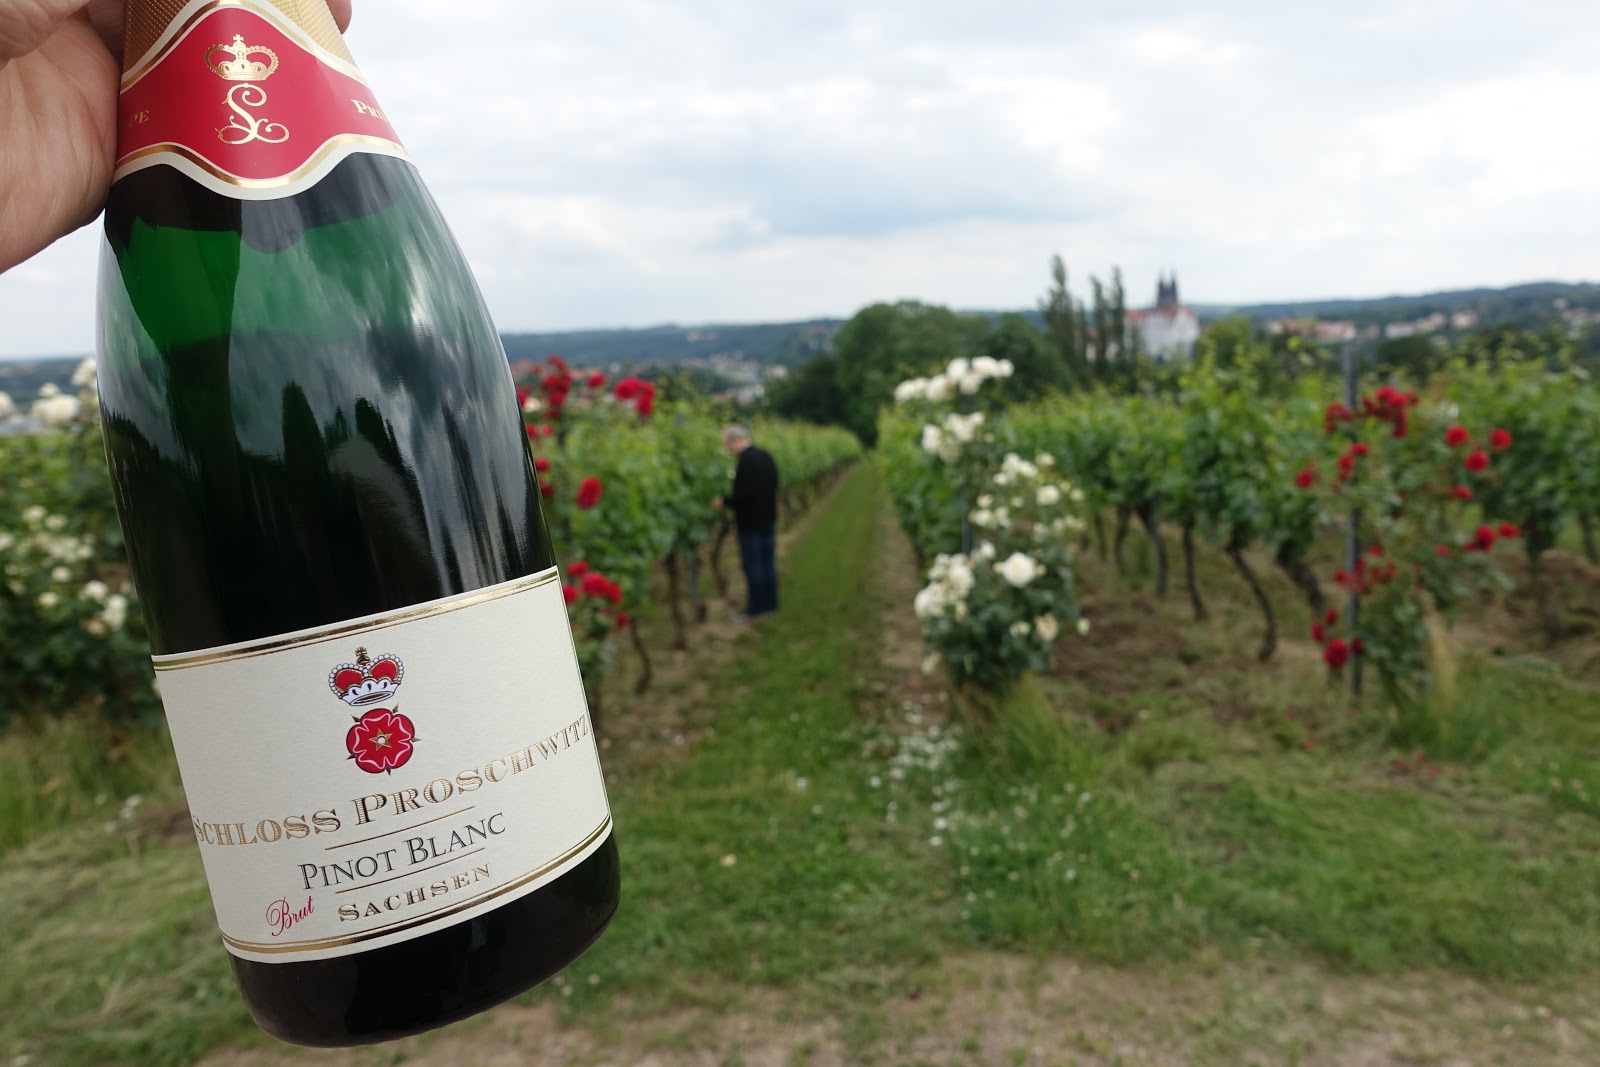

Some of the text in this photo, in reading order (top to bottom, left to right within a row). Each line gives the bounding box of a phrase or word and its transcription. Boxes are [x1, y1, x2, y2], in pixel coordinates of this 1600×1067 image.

[192, 714, 589, 846] SCHLOSS PROSCHWITZ
[297, 812, 506, 891] PINOT BLANC
[265, 895, 315, 937] Brut
[337, 863, 491, 922] SACHSEN
